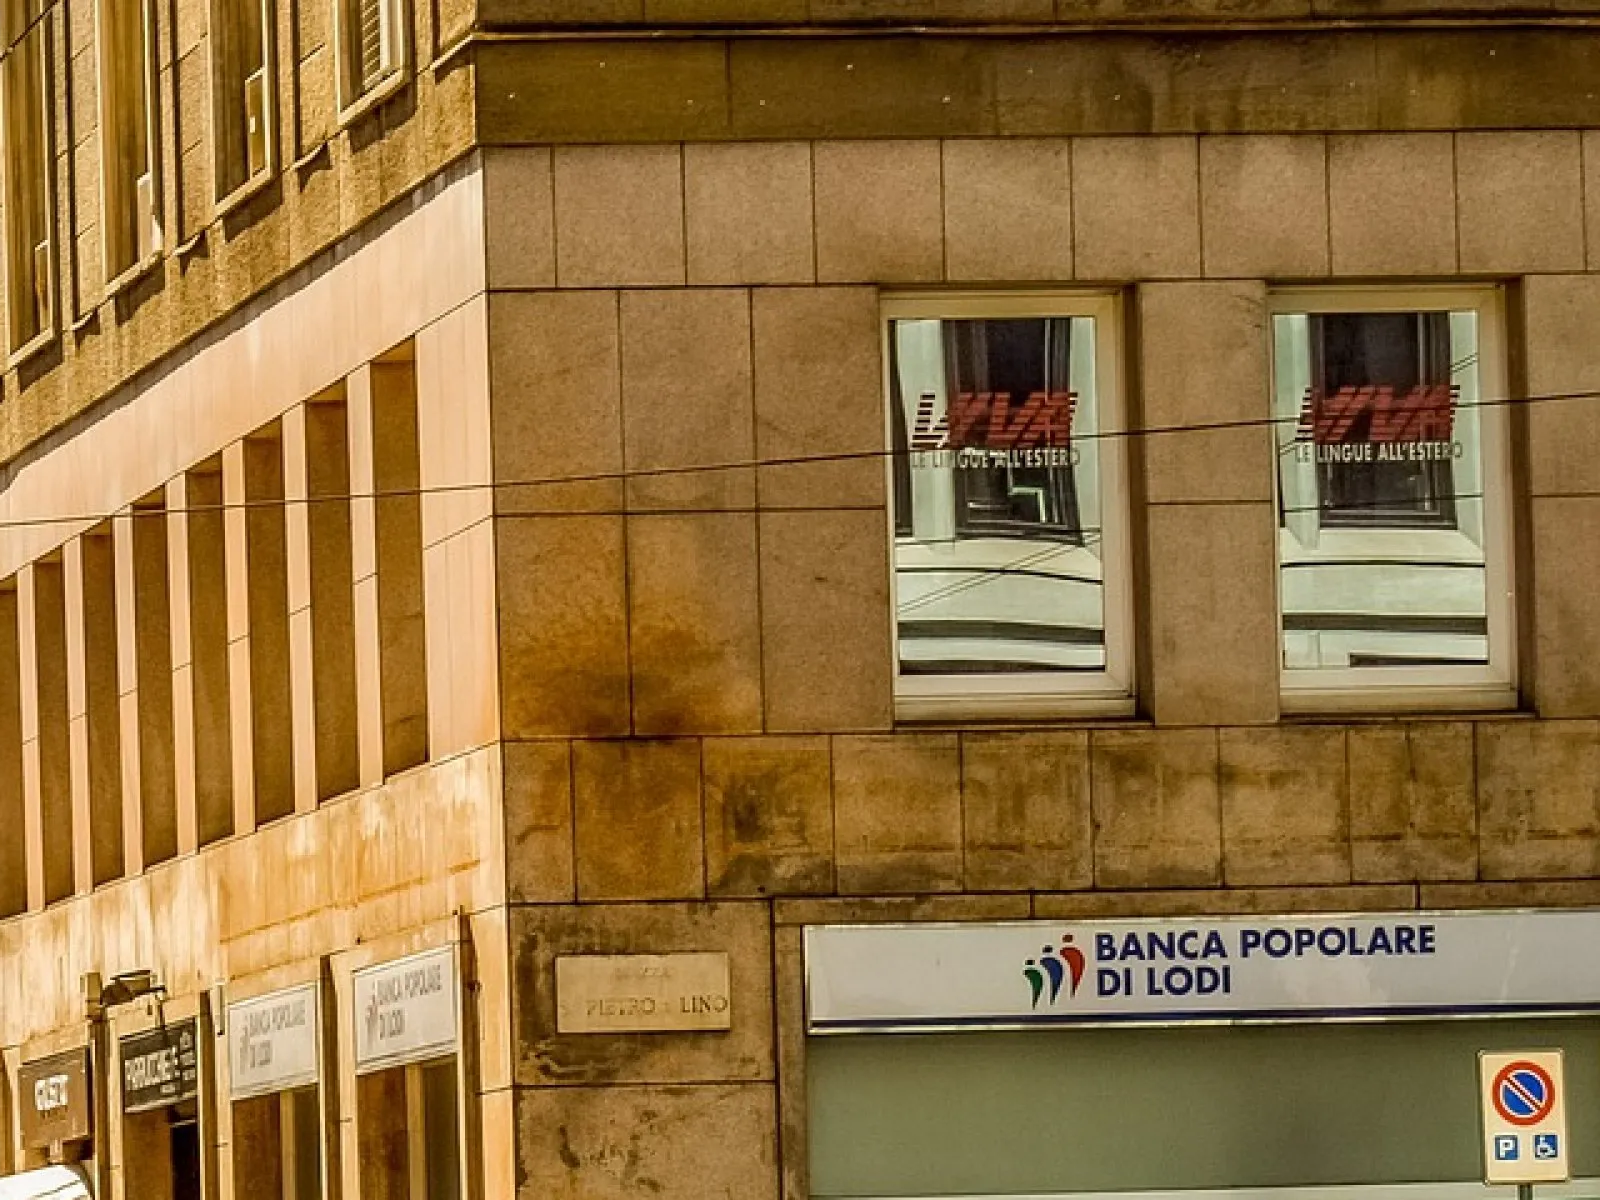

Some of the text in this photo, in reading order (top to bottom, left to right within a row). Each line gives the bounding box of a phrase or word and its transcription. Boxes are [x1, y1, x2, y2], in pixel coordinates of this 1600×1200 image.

[1316, 442, 1372, 464] LINGUE
[1377, 440, 1463, 462] ALL'ESTERO
[1094, 924, 1437, 962] BANCA POPOLARE
[1096, 963, 1232, 997] DI LODI
[678, 994, 728, 1014] LINO
